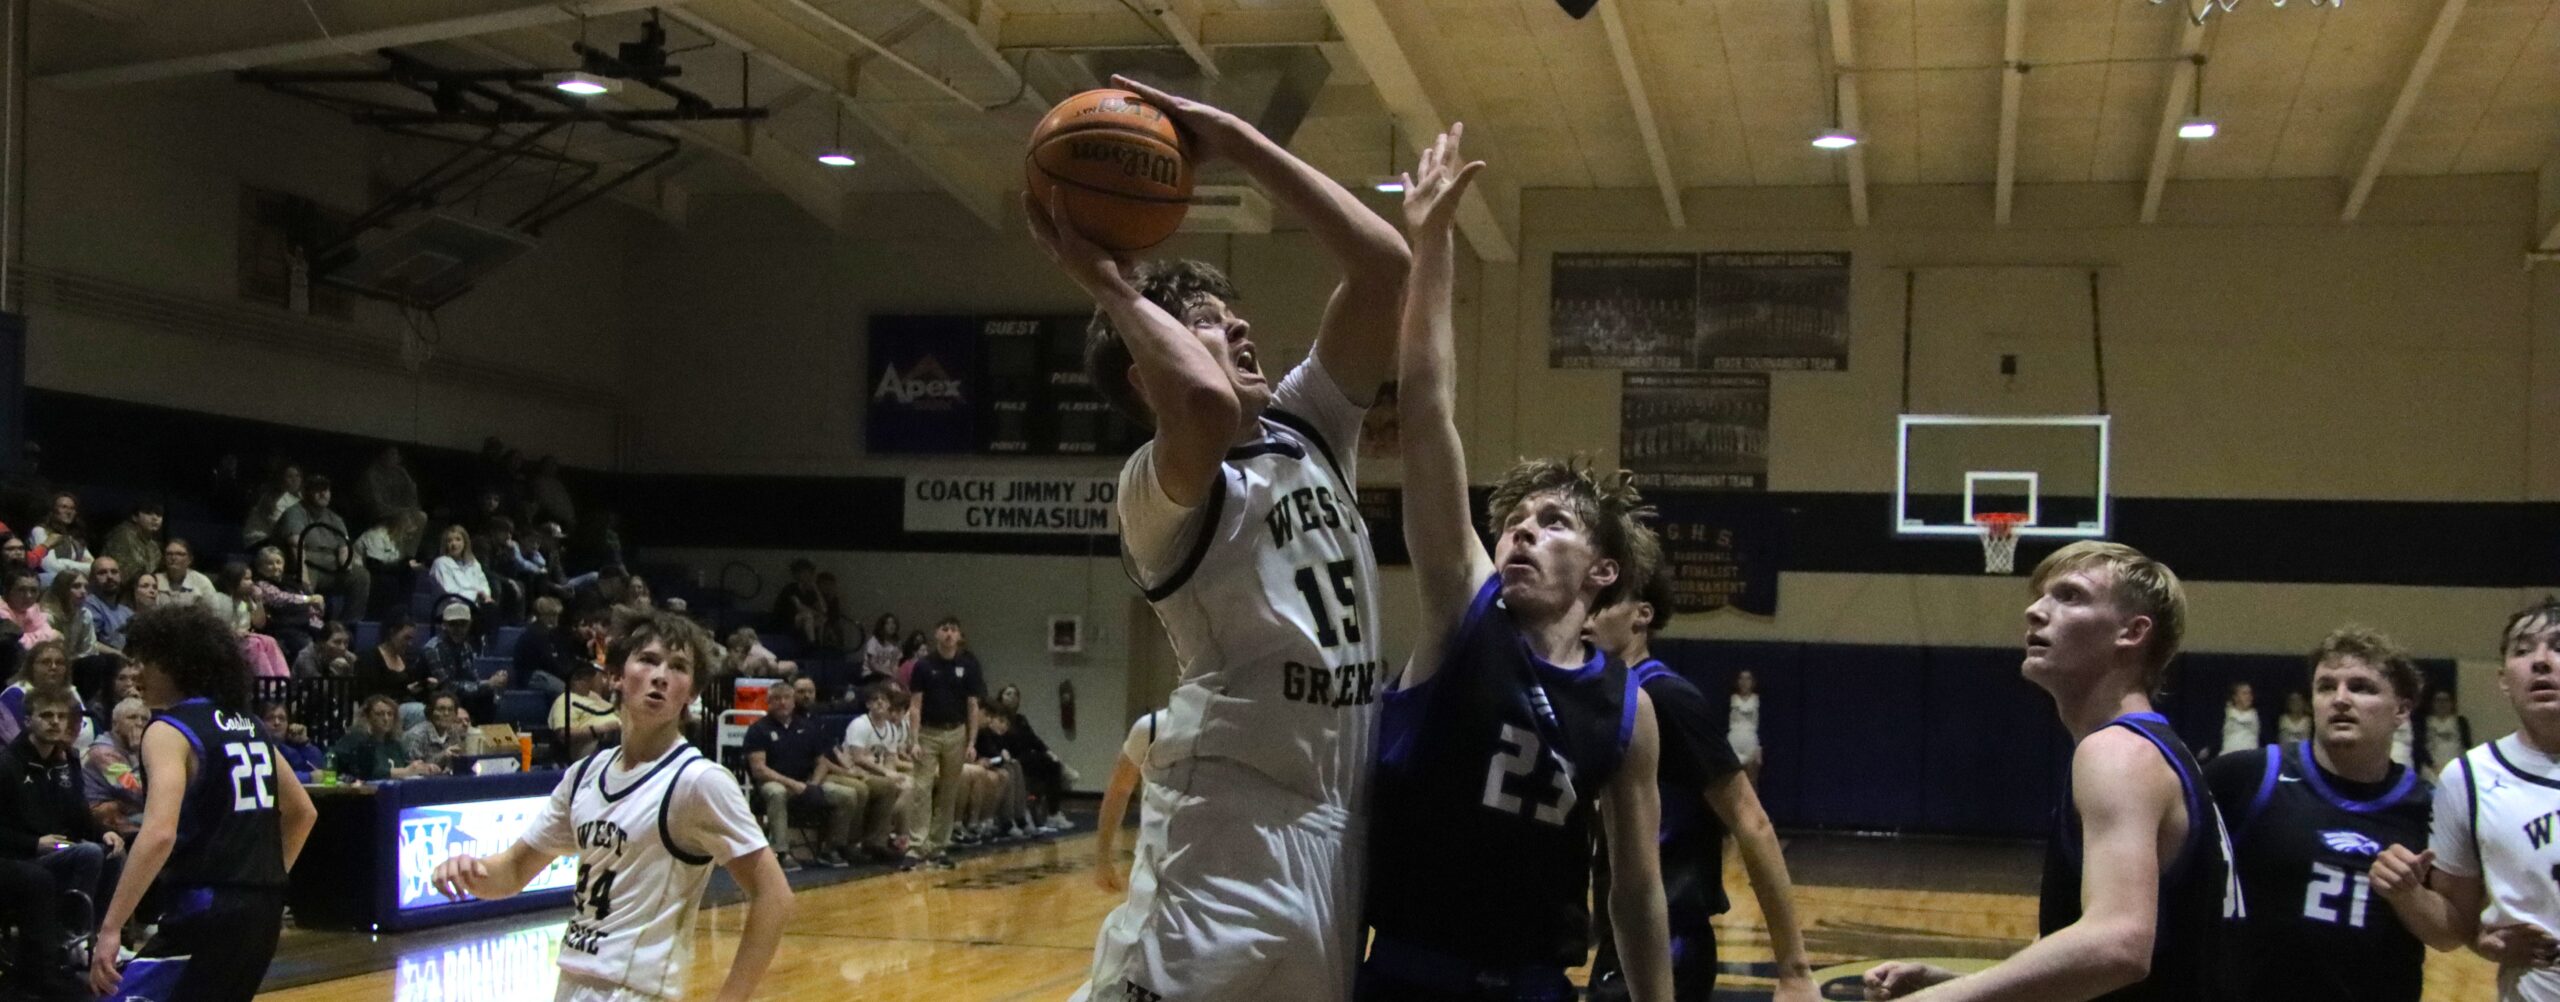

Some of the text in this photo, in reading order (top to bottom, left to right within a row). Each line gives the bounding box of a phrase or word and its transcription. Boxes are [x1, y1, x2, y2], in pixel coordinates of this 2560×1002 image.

[985, 320, 1040, 335] GUEST
[1561, 355, 1681, 368] STATE TOURNAMENT TEAM
[1713, 356, 1836, 370] STATE TOURNAMENT TEAM
[874, 361, 962, 404] Apex
[916, 481, 1119, 503] COACH JIMMY JO
[1632, 474, 1755, 488] STATE TOURNAMENT TEAM
[966, 507, 1108, 530] GYMNASIUM
[1681, 565, 1739, 578] FINALIST
[1295, 559, 1361, 648] 15
[213, 709, 255, 738] Cosby
[225, 741, 275, 812] 22
[1482, 723, 1578, 826] 23
[577, 819, 627, 857] WEST
[2304, 861, 2371, 928] 21
